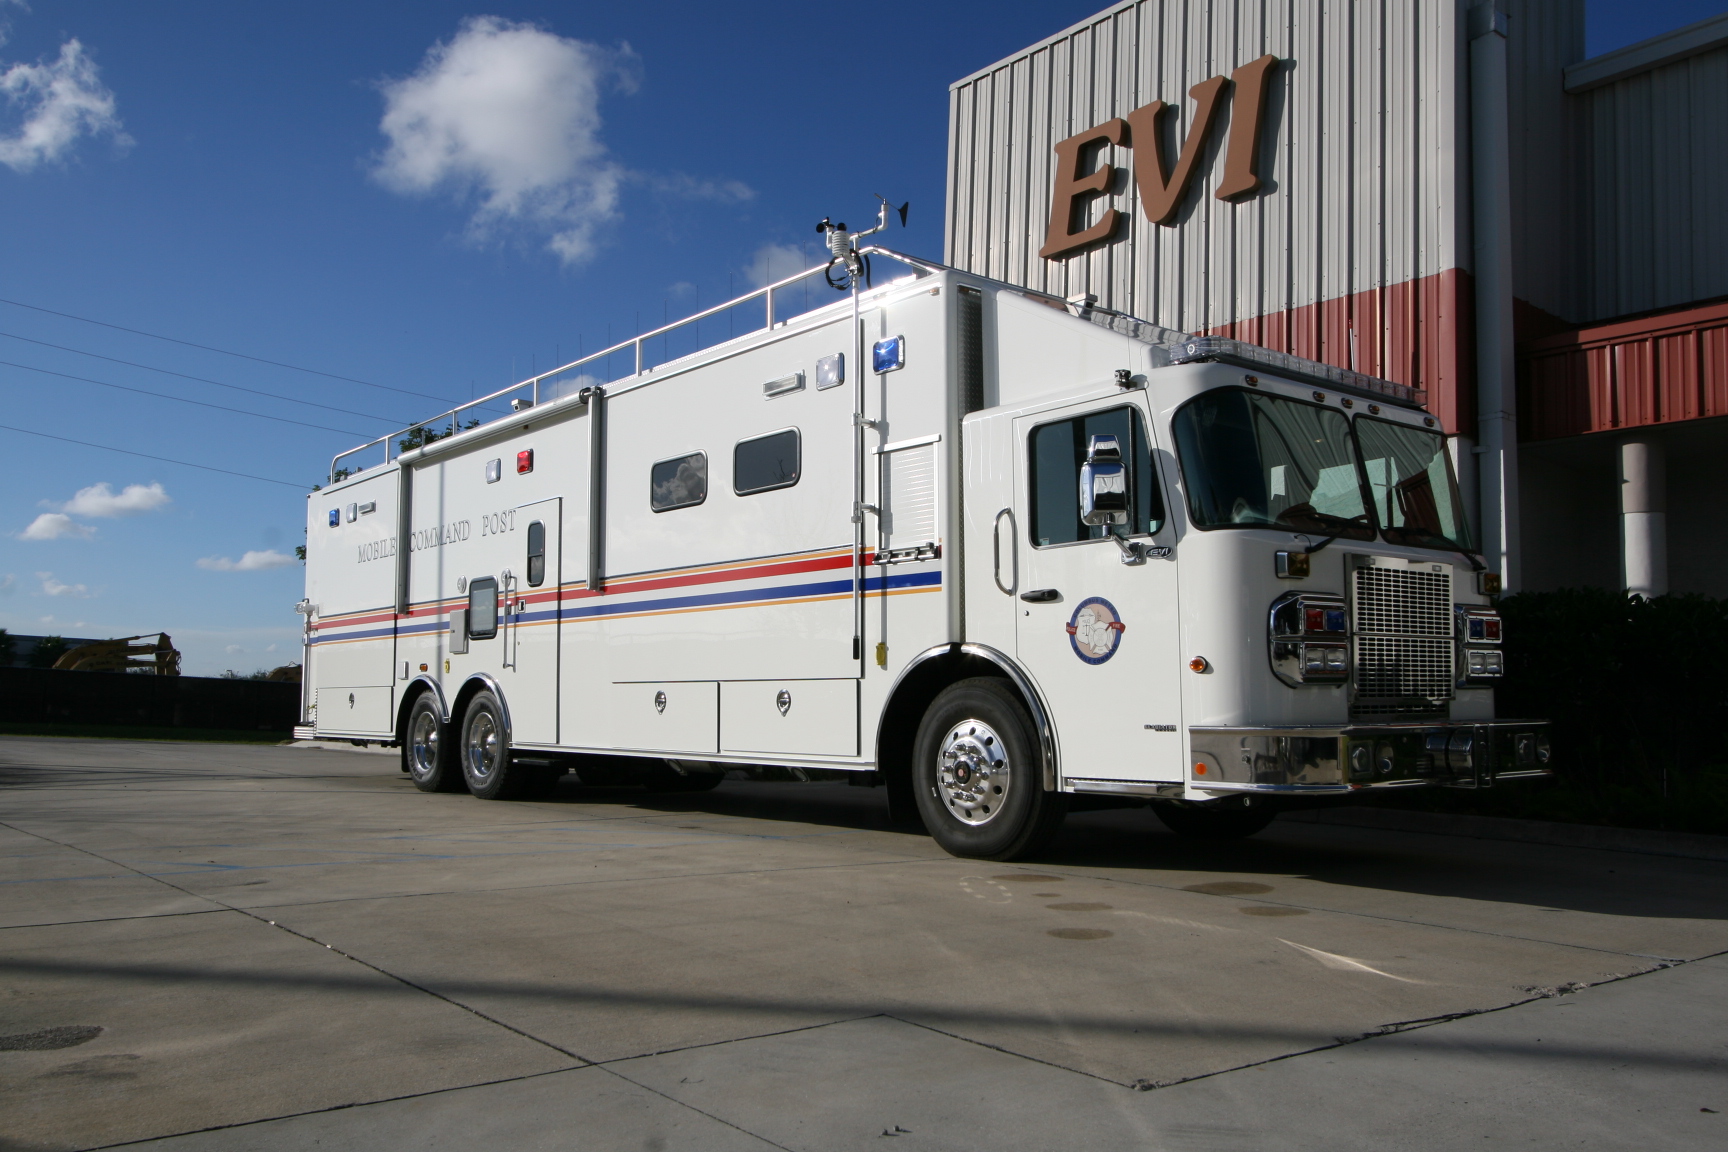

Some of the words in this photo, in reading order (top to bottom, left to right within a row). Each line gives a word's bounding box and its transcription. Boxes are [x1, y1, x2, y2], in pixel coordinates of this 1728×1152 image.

[1038, 53, 1280, 259] EVI
[357, 536, 396, 564] MOBILE
[409, 519, 471, 552] COMMAND
[481, 509, 517, 537] POST
[1150, 547, 1169, 556] EVI
[1092, 644, 1118, 664] COMMAND
